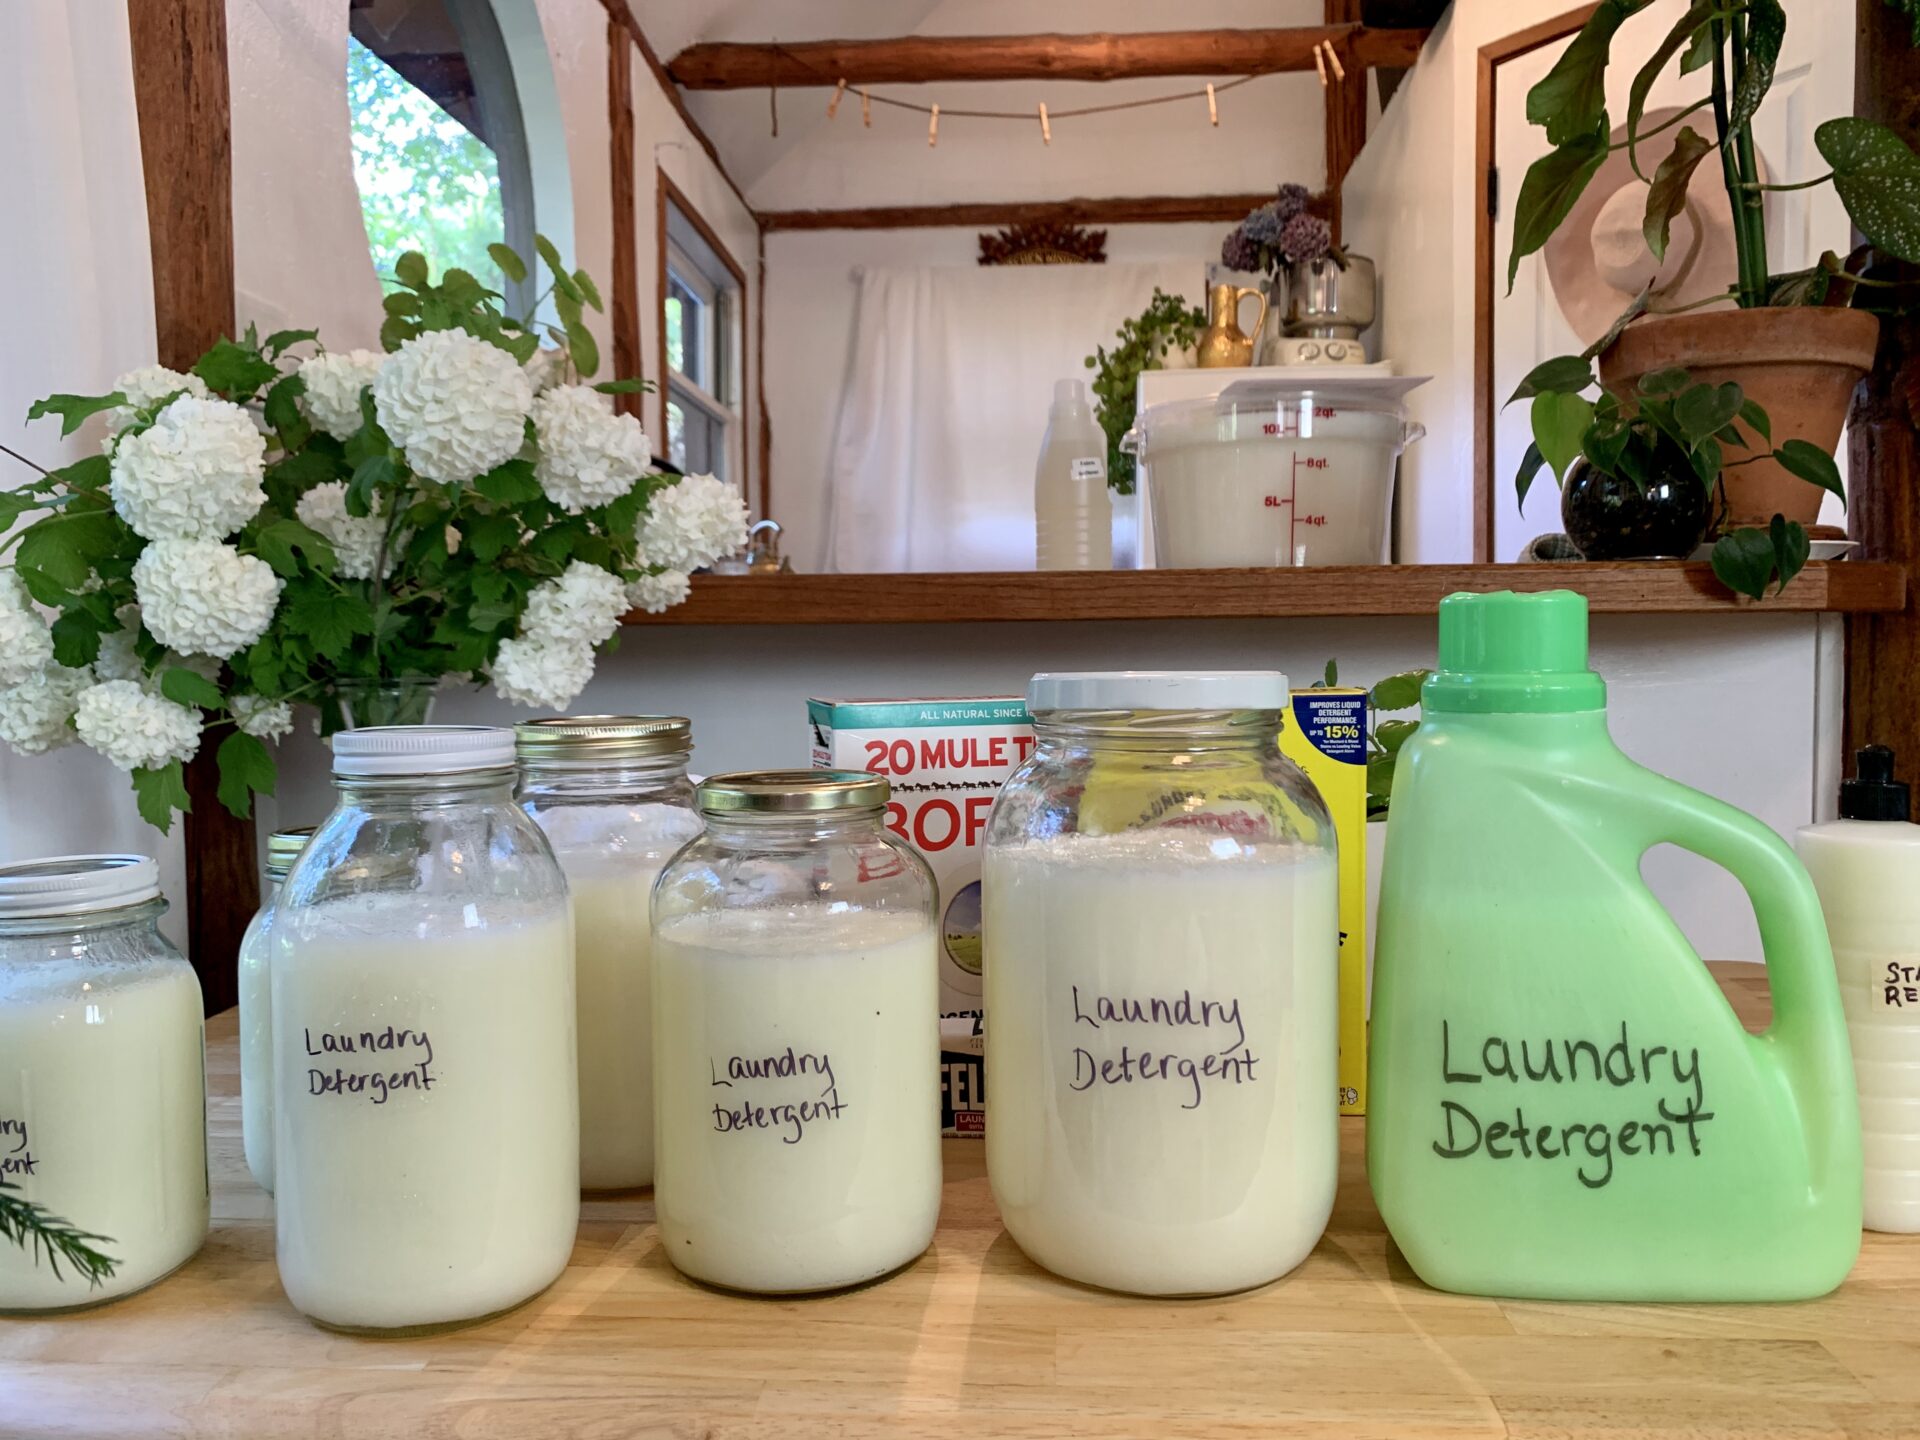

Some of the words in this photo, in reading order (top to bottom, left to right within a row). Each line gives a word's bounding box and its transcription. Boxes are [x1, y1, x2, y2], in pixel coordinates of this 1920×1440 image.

[1264, 496, 1281, 507] 5L
[920, 710, 940, 720] ALL
[943, 709, 990, 719] NATURAL
[993, 708, 1023, 718] SINCE
[1310, 701, 1340, 709] IMPROVES
[865, 739, 915, 776] 20
[920, 737, 1008, 769] MULE
[1013, 736, 1037, 763] T
[1884, 985, 1920, 1008] RE
[1073, 986, 1245, 1056] Laundry
[305, 1026, 434, 1063] Laundry
[308, 1060, 438, 1104] Detergent
[711, 1047, 835, 1098] Laundry
[1069, 1047, 1261, 1110] Detergent
[1443, 1020, 1706, 1122] Laundry
[0, 1119, 28, 1153] ry
[711, 1088, 849, 1145] Detergent
[1432, 1099, 1715, 1190] Detergent
[0, 1152, 40, 1183] ent
